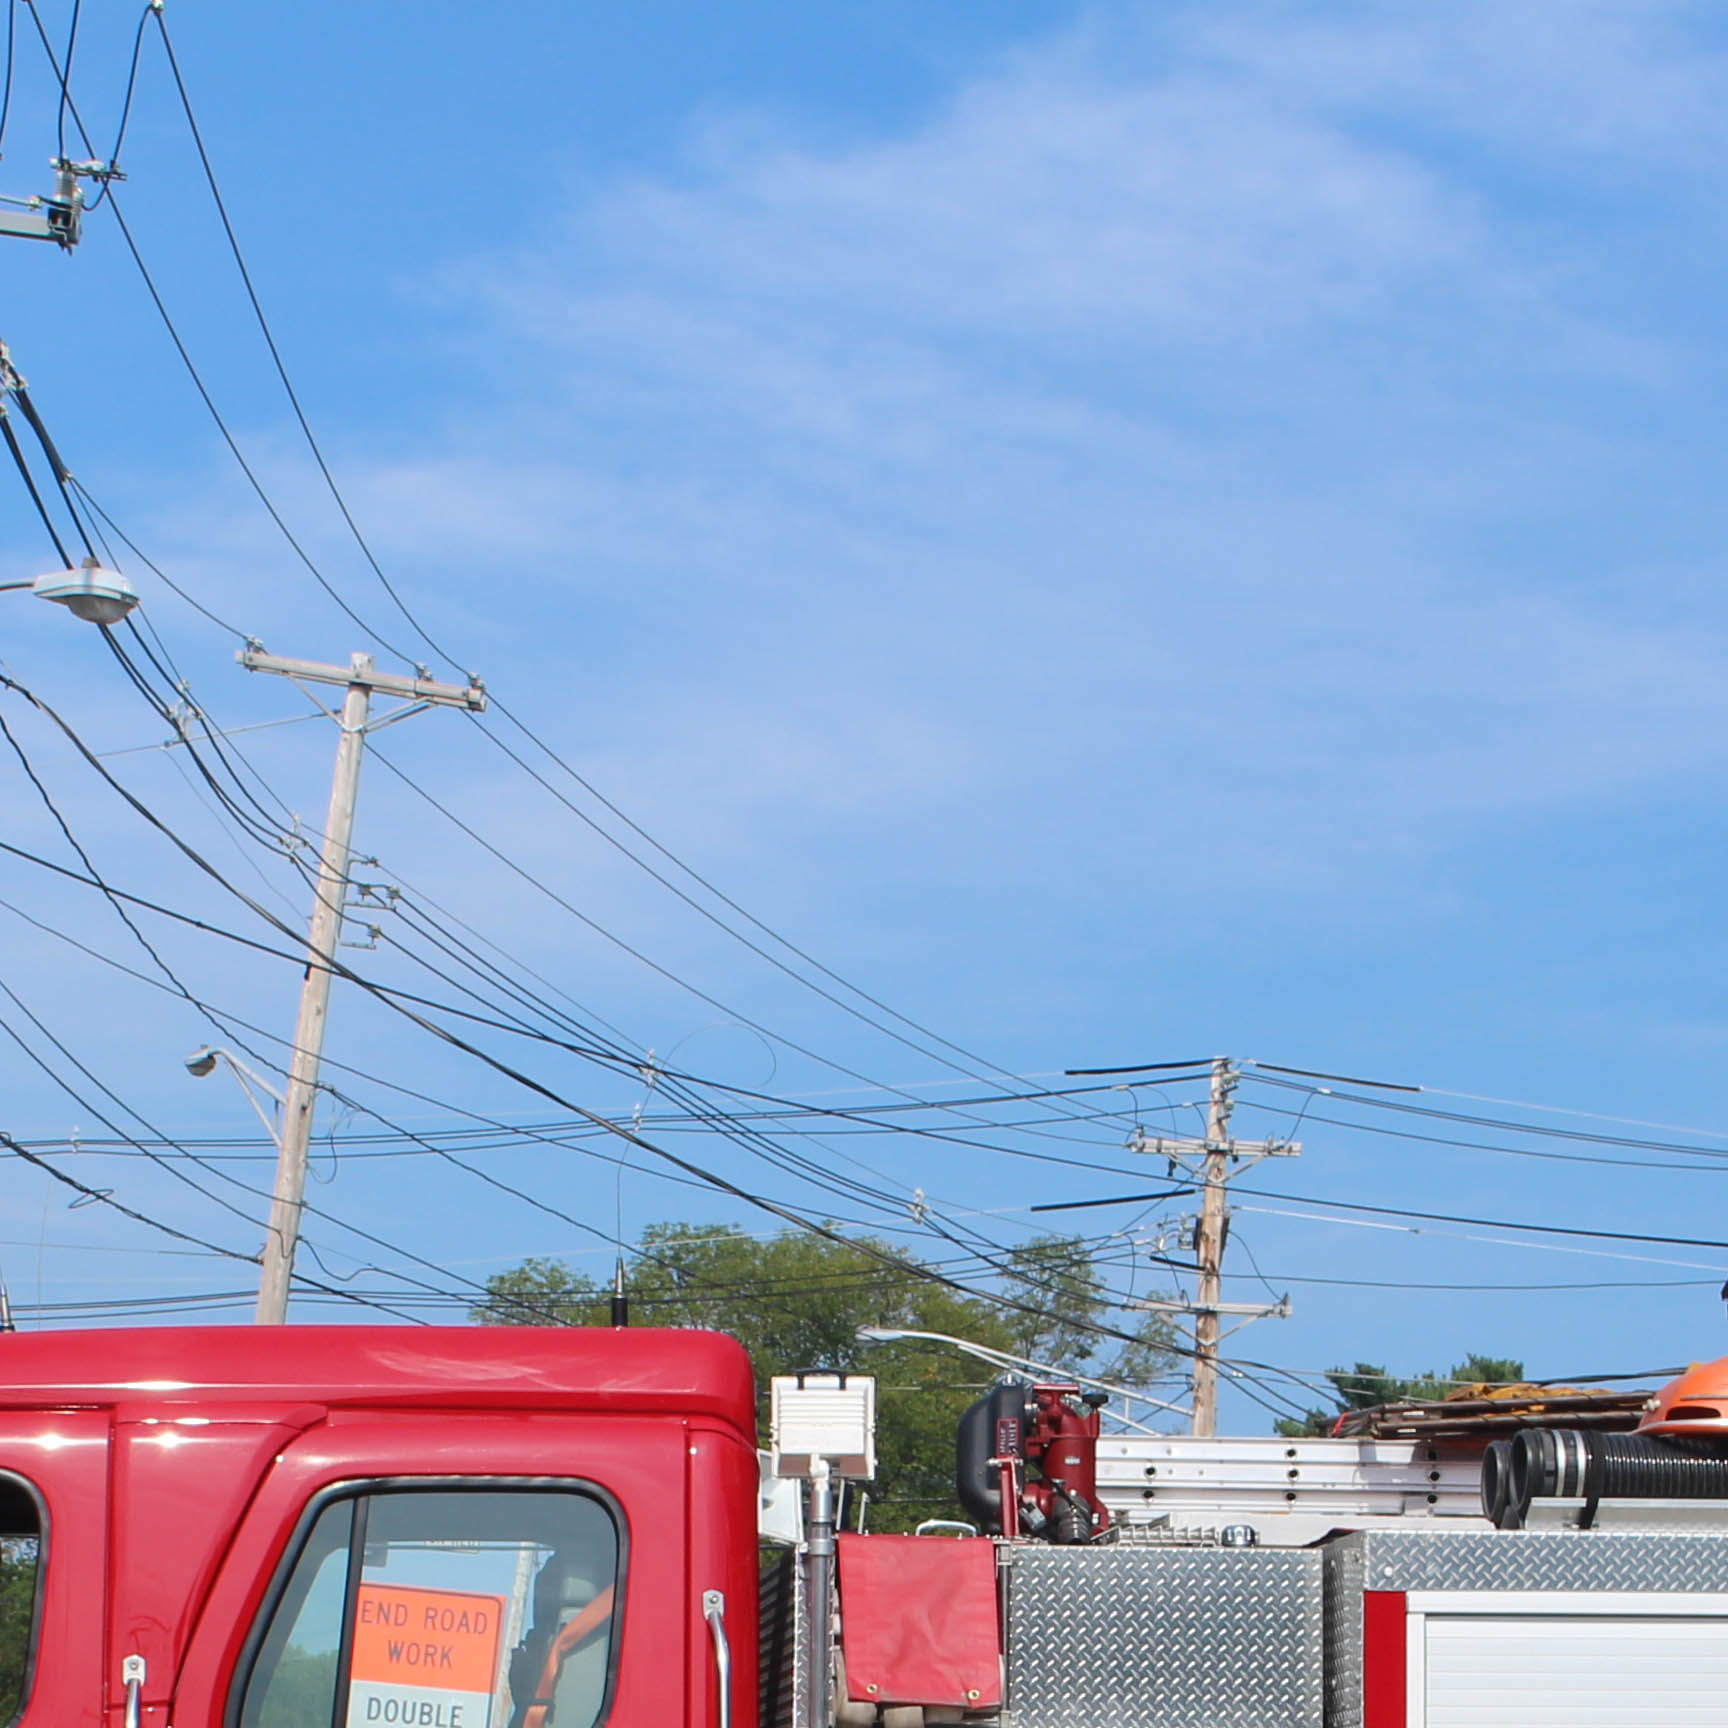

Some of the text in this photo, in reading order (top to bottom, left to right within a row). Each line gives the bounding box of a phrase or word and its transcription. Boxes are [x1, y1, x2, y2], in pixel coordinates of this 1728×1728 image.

[360, 1600, 488, 1635] END ROAD
[388, 1640, 455, 1669] WORK
[366, 1697, 464, 1728] DOUBLE
